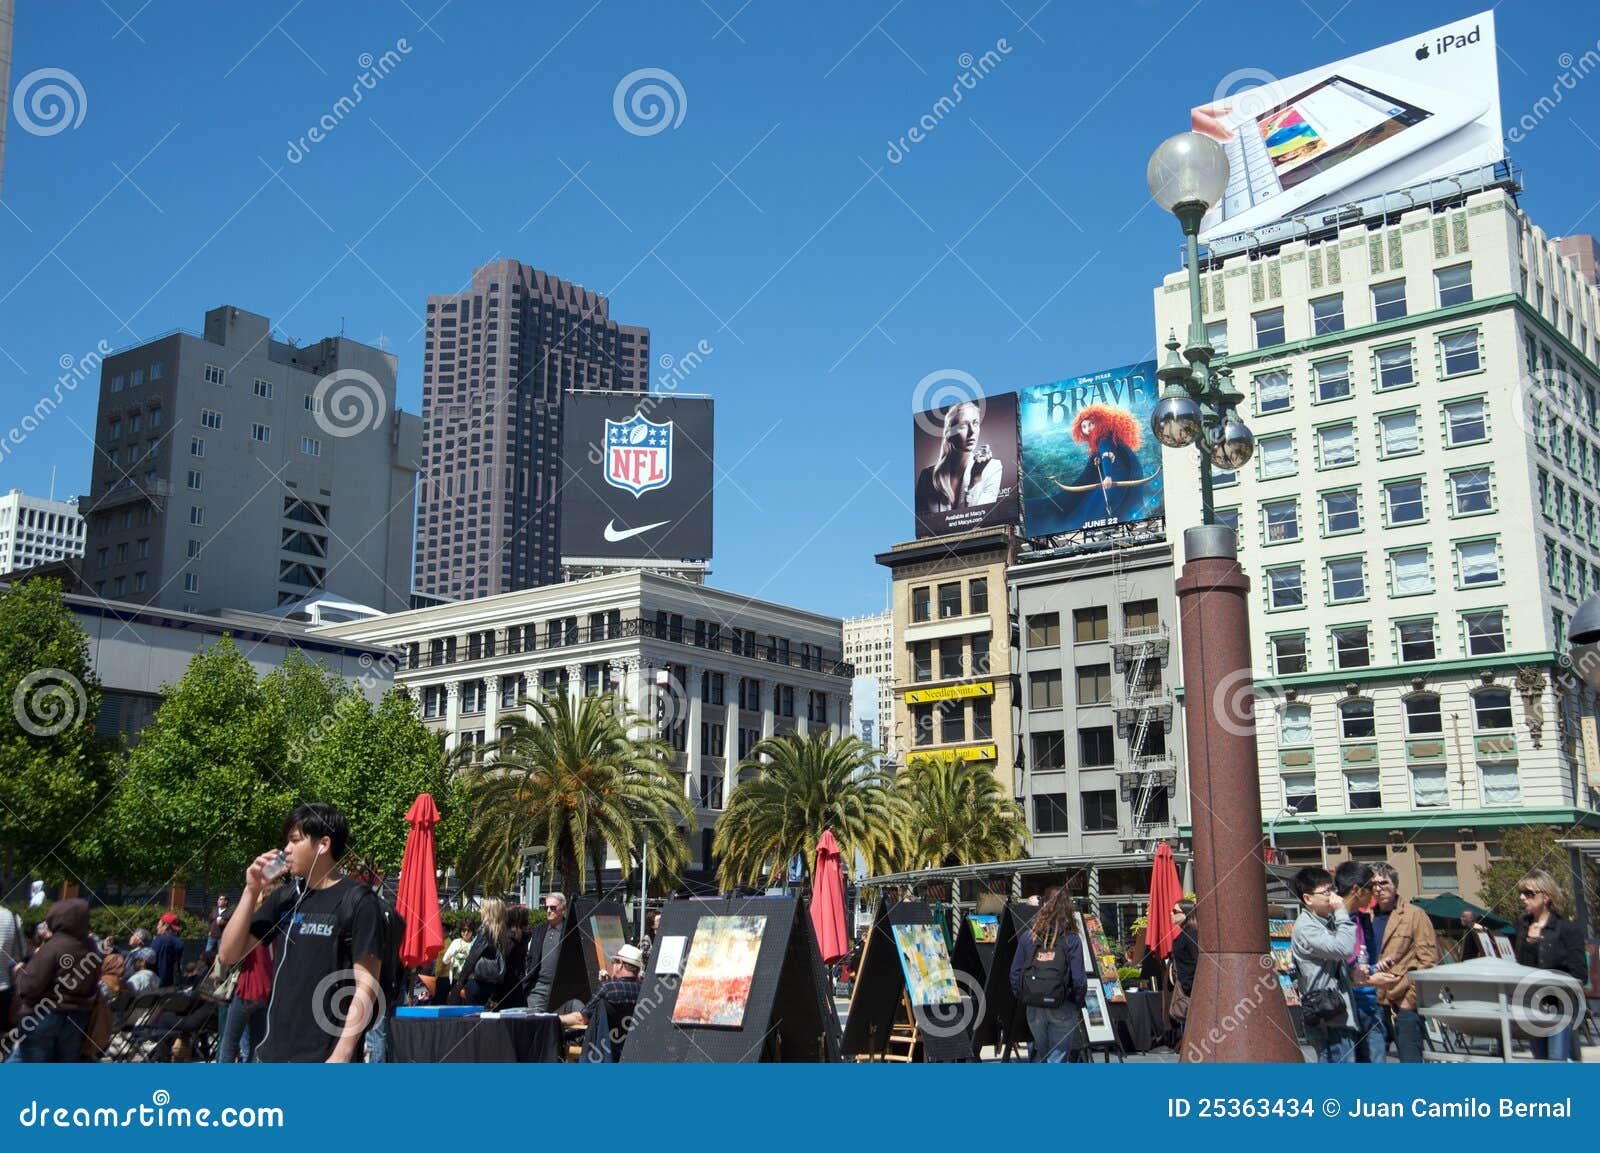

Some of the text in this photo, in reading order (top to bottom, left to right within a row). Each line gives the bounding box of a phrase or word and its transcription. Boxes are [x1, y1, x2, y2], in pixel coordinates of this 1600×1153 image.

[1436, 25, 1481, 55] iPad
[1043, 375, 1145, 421] BRAVE
[612, 449, 664, 485] NFL
[1082, 517, 1118, 529] JUNE 22
[656, 688, 664, 760] NIKETW
